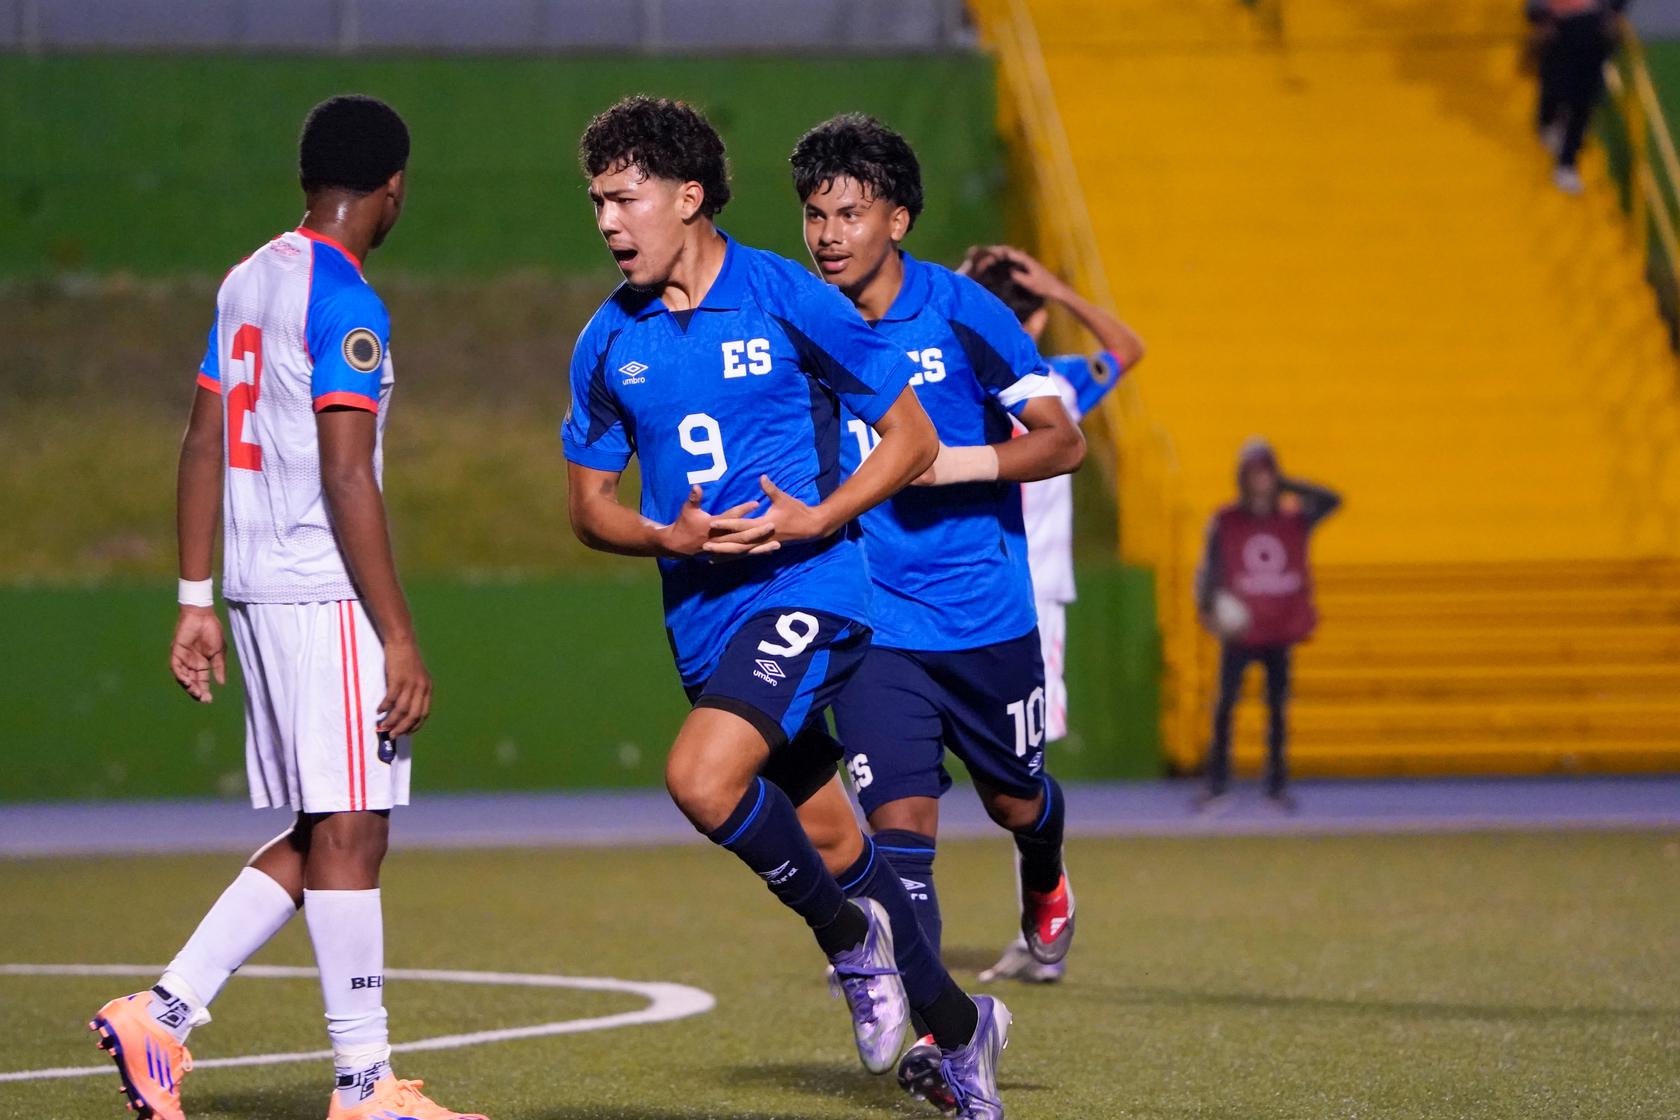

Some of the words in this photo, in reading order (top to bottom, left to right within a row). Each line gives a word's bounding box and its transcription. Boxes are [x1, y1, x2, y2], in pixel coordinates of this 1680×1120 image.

[622, 376, 646, 386] umbro
[722, 338, 772, 379] ES
[227, 322, 263, 471] 2
[678, 413, 728, 485] 9
[757, 611, 820, 658] 9
[753, 669, 778, 687] umbro
[1006, 686, 1045, 758] 10
